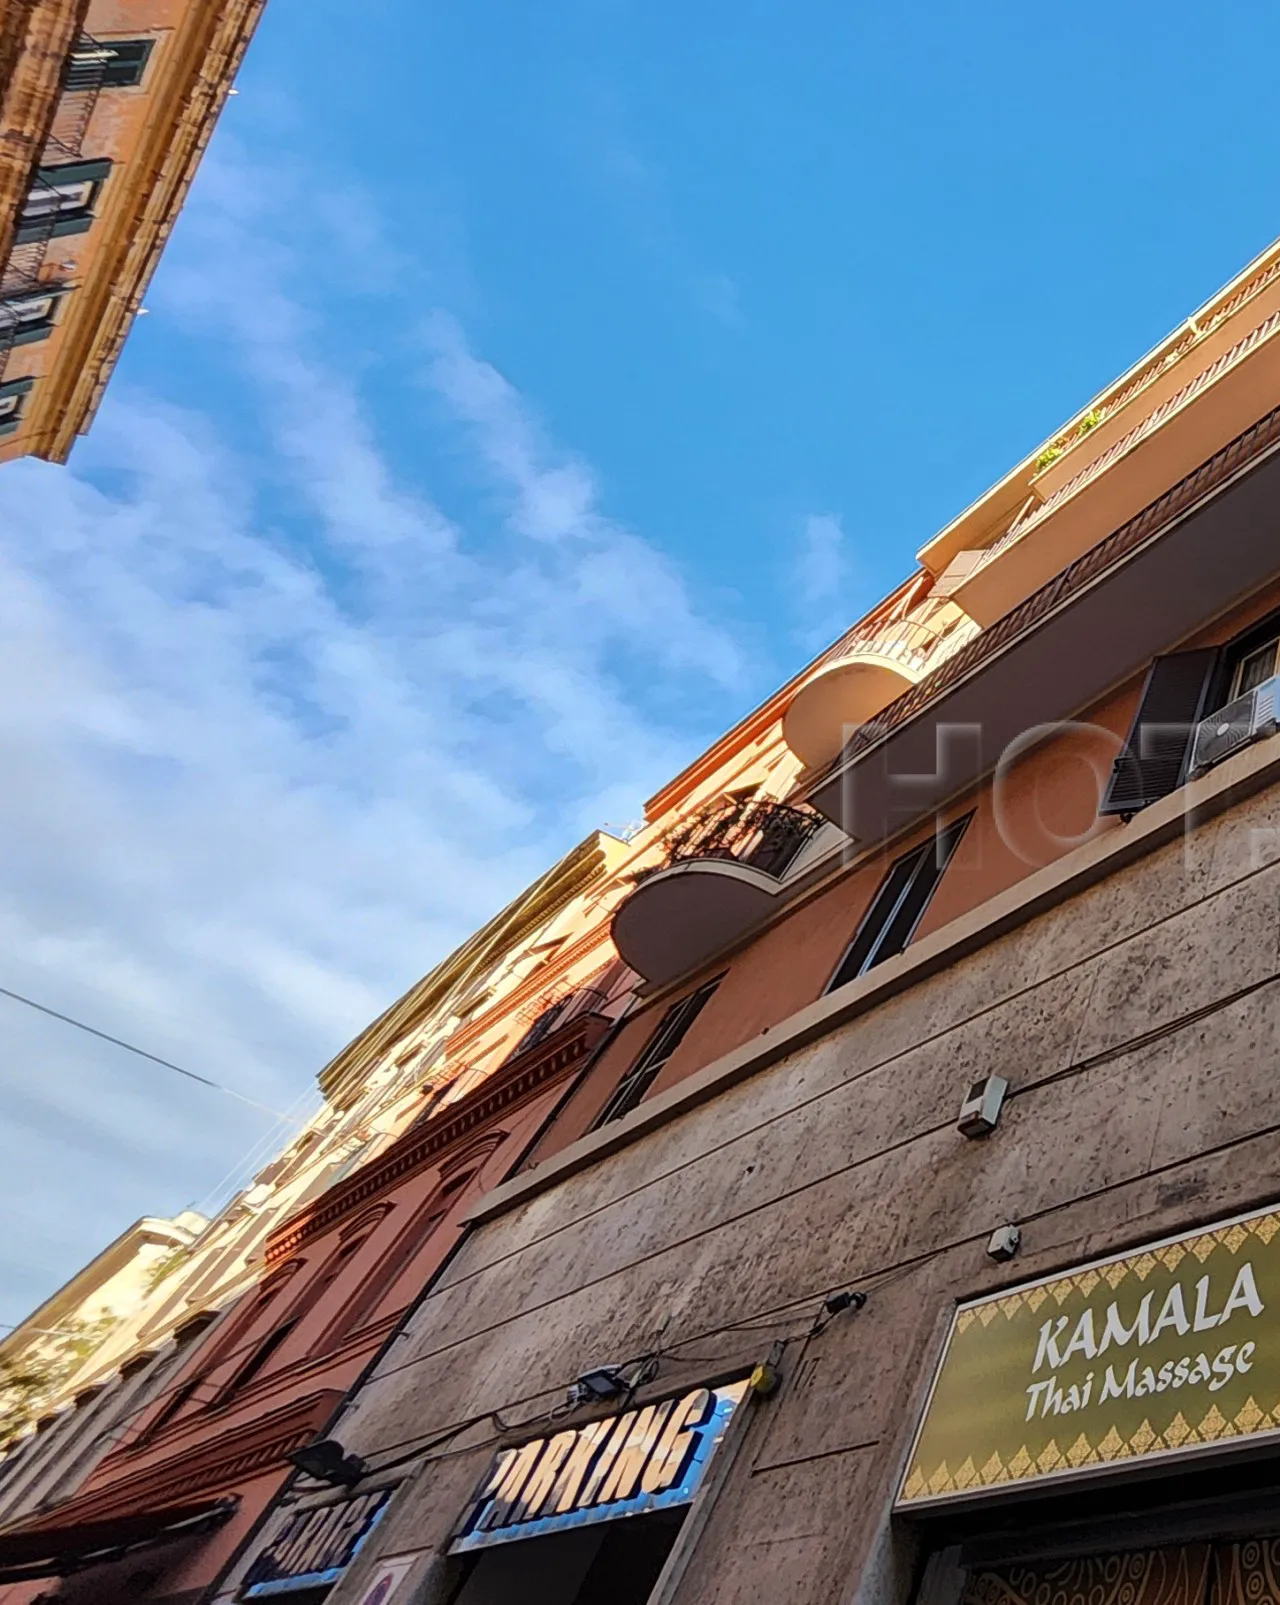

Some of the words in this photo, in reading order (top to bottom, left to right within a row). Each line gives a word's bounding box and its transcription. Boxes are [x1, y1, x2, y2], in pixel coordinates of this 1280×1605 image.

[1032, 1262, 1265, 1374] KAMALA
[1025, 1372, 1095, 1422] Thai
[1098, 1341, 1256, 1406] Massage
